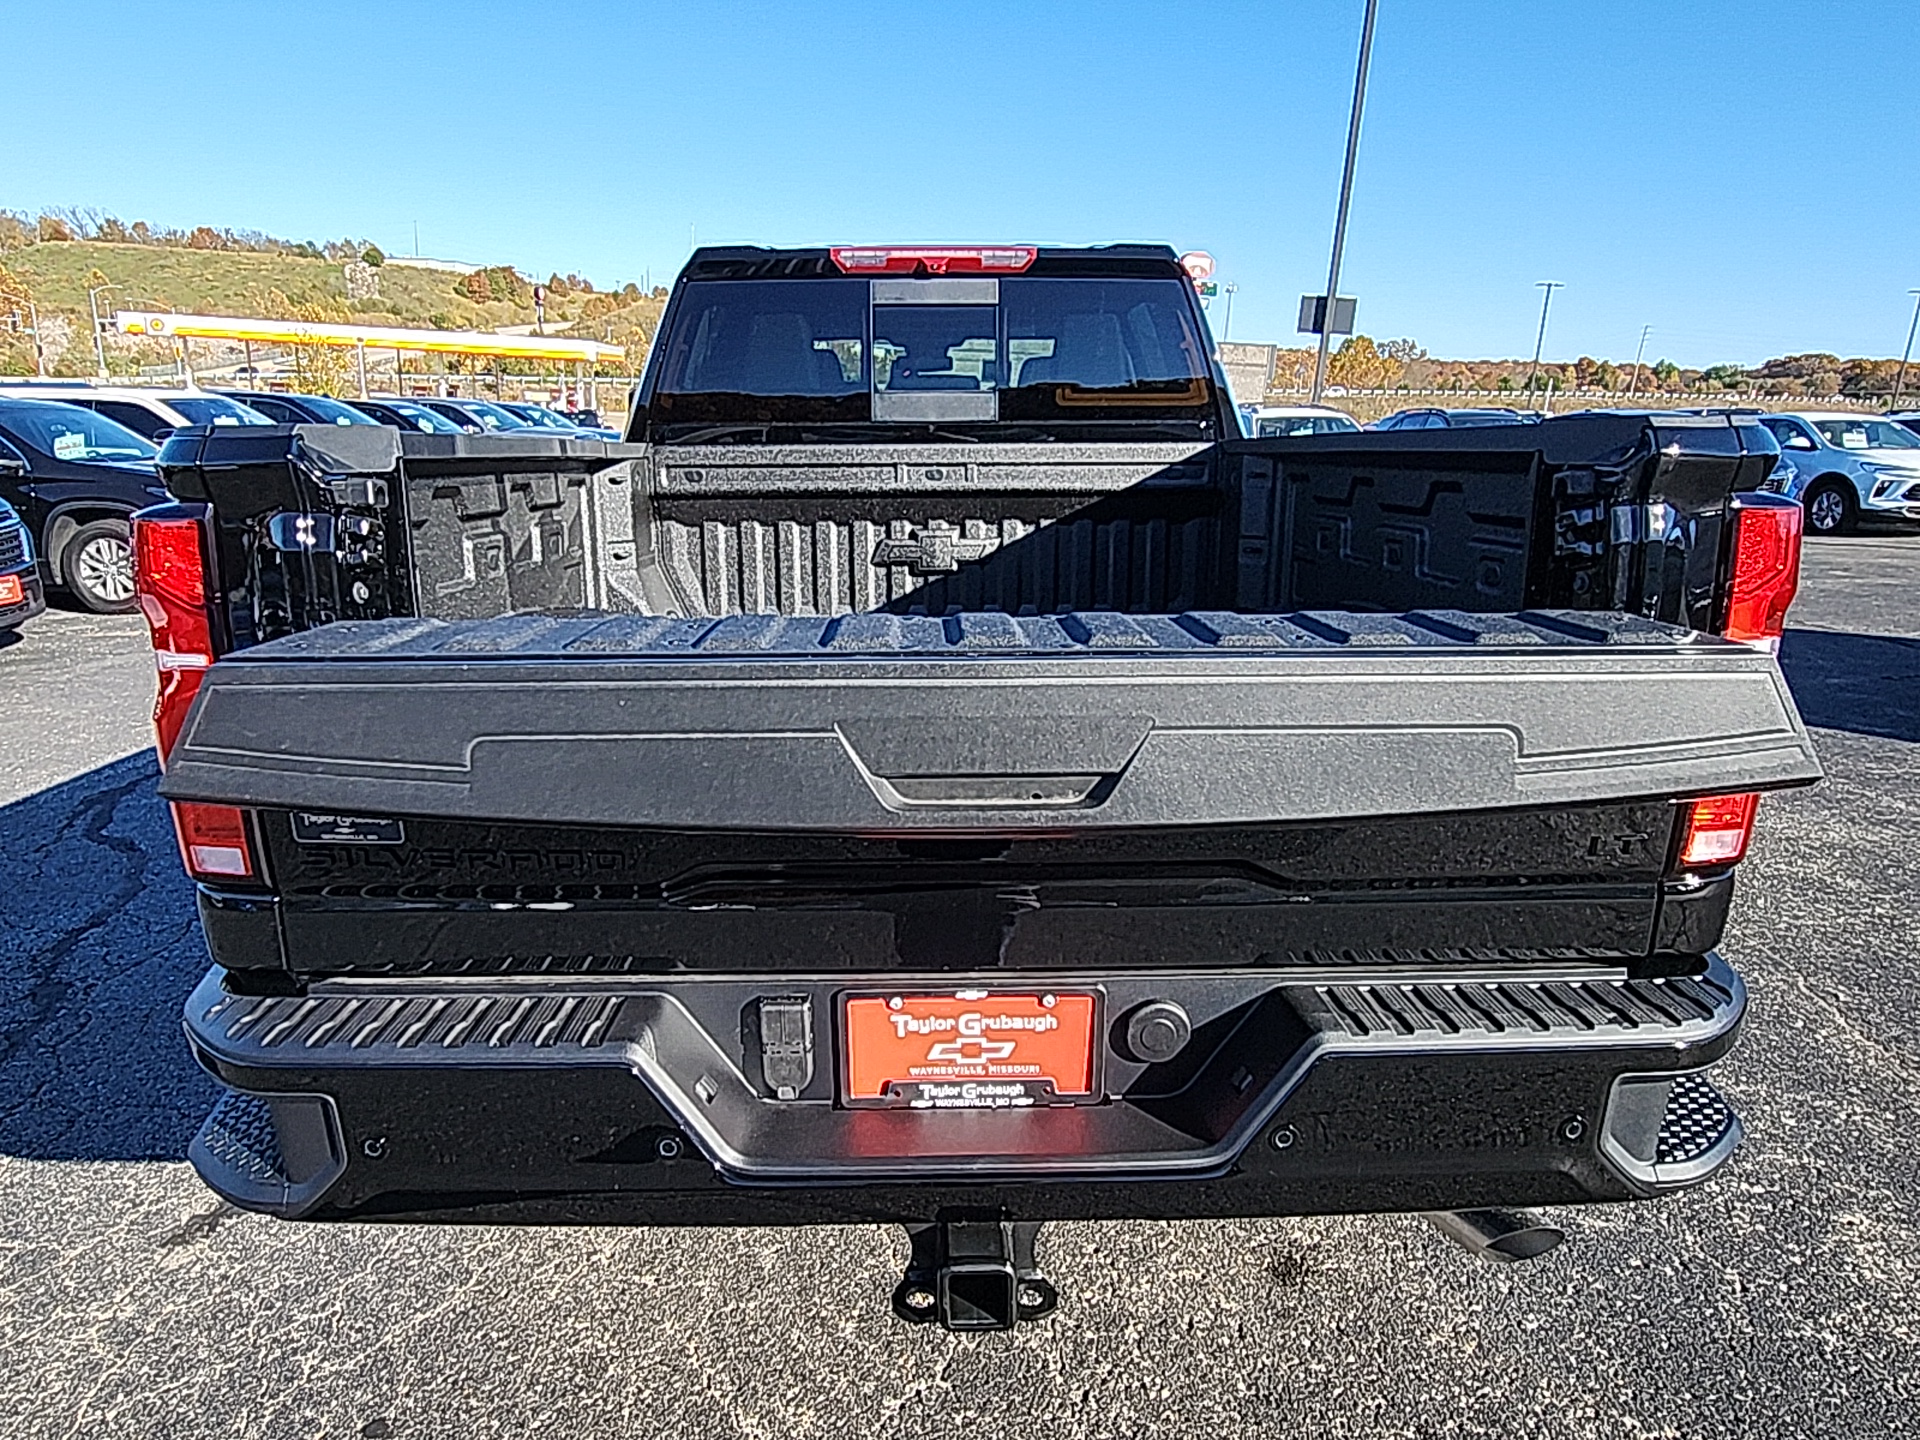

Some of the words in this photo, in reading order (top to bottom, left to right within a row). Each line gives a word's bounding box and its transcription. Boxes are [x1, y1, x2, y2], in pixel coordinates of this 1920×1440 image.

[299, 847, 626, 870] SILVERADO
[889, 1014, 956, 1038] Taylor
[958, 1012, 1058, 1036] Grubaugh
[988, 1065, 1041, 1076] MISSOURI
[919, 1084, 960, 1098] Taylor
[962, 1083, 1025, 1098] Grubaugh
